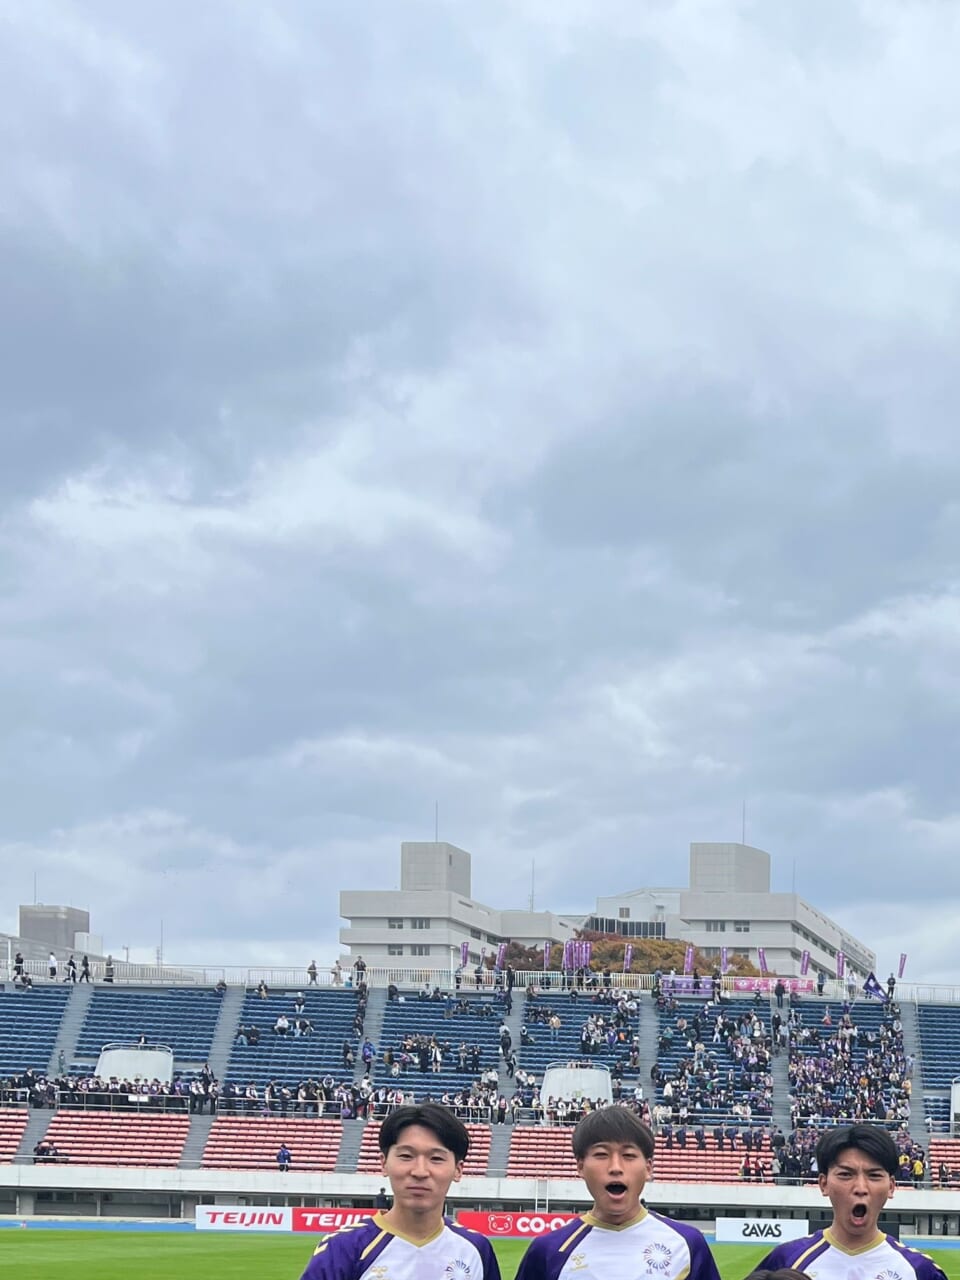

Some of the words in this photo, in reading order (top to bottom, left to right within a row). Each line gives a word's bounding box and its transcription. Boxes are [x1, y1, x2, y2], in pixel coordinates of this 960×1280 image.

[205, 1211, 284, 1227] TEIJIN
[300, 1213, 374, 1227] TEIJI
[742, 1223, 782, 1237] SAVAS
